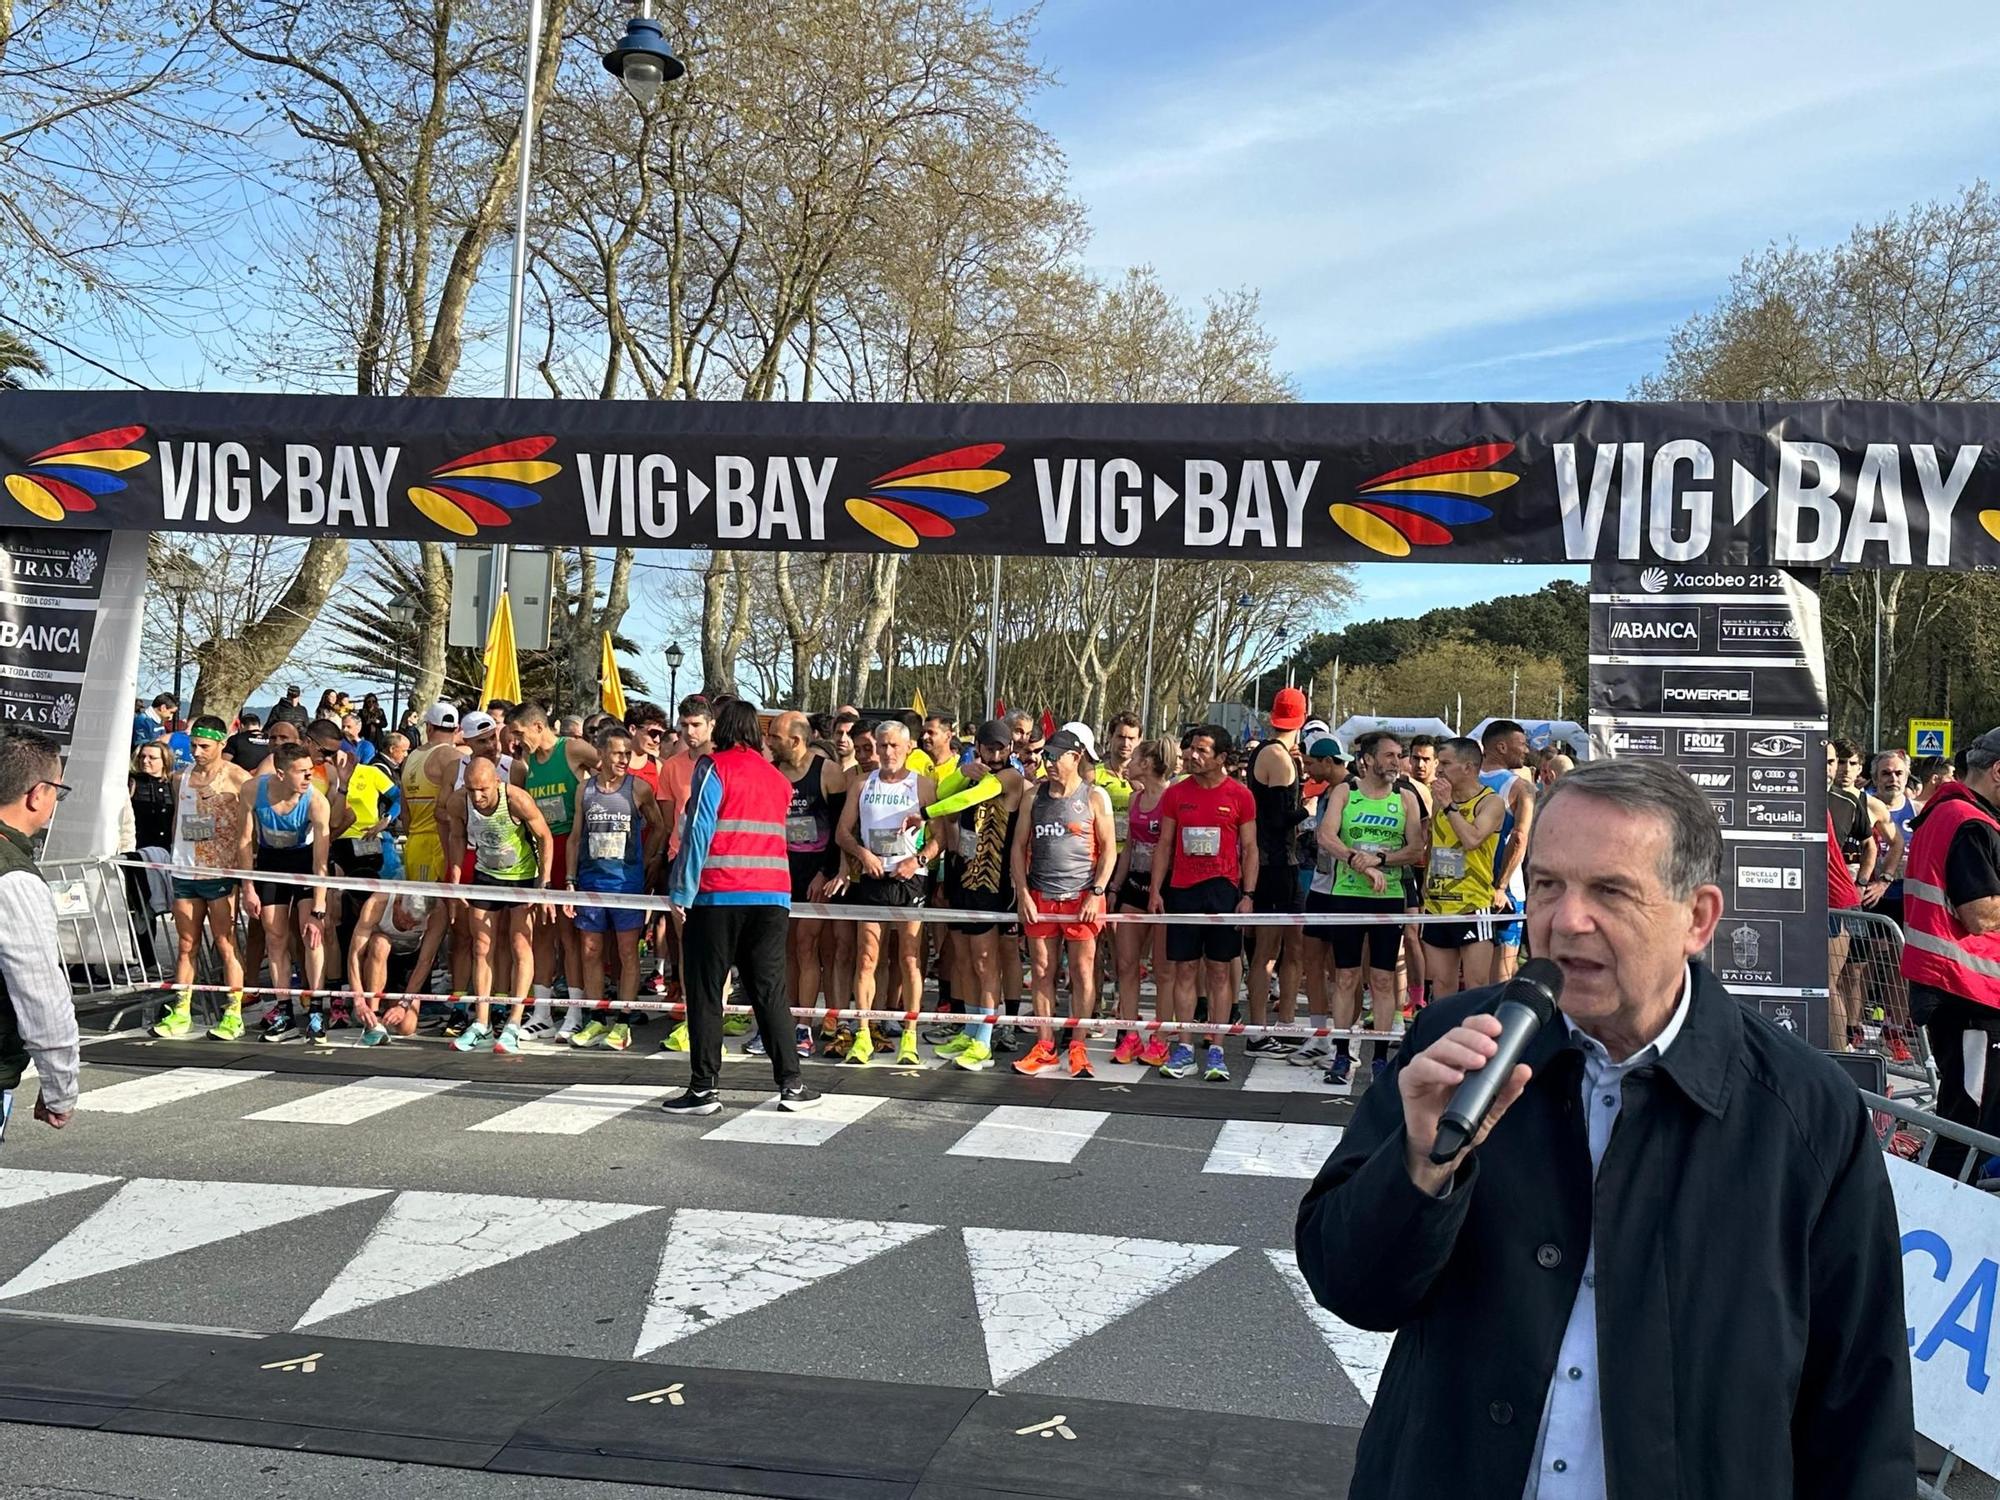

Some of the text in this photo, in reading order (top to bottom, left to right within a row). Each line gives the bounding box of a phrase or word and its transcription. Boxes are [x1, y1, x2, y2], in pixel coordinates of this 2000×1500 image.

[158, 440, 400, 528] VIG BAY
[576, 452, 838, 541] VIG BAY
[1033, 457, 1320, 548] VIG BAY
[1553, 439, 1983, 566] VIG BAY
[1674, 573, 1745, 588] Xacobeo
[1722, 626, 1788, 637] VIEIRASA
[9, 668, 29, 677] TODA
[1664, 688, 1751, 701] POWERADE
[1684, 733, 1725, 748] FROIZ
[1752, 783, 1799, 793] Vepersa
[864, 793, 910, 806] PORTUGAL
[588, 812, 632, 822] castrelos
[1352, 812, 1398, 828] jmm
[1756, 809, 1803, 823] aqualia
[1191, 840, 1213, 854] 218
[1437, 863, 1456, 875] 148
[1742, 870, 1778, 878] CONCELLO
[1722, 973, 1772, 982] BAIONA
